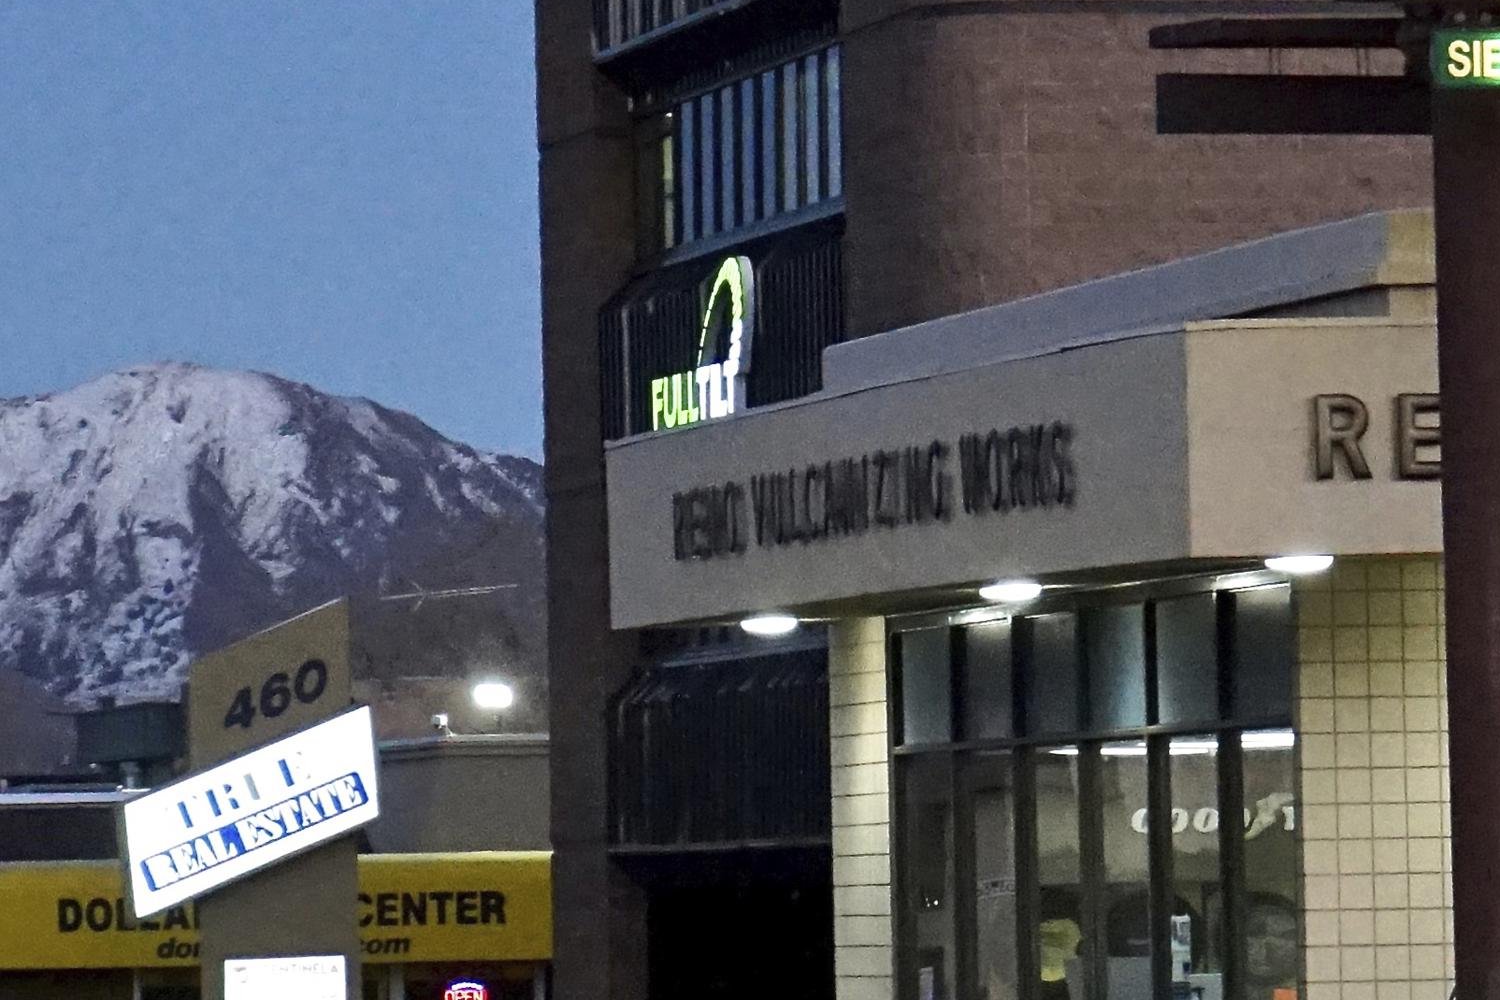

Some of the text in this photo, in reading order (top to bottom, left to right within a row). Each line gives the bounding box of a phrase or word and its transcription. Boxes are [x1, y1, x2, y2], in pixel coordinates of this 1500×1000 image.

[957, 419, 1078, 515] WORKS
[223, 658, 328, 731] 460
[144, 773, 366, 890] REAL ESTATE
[58, 896, 200, 933] DOLA
